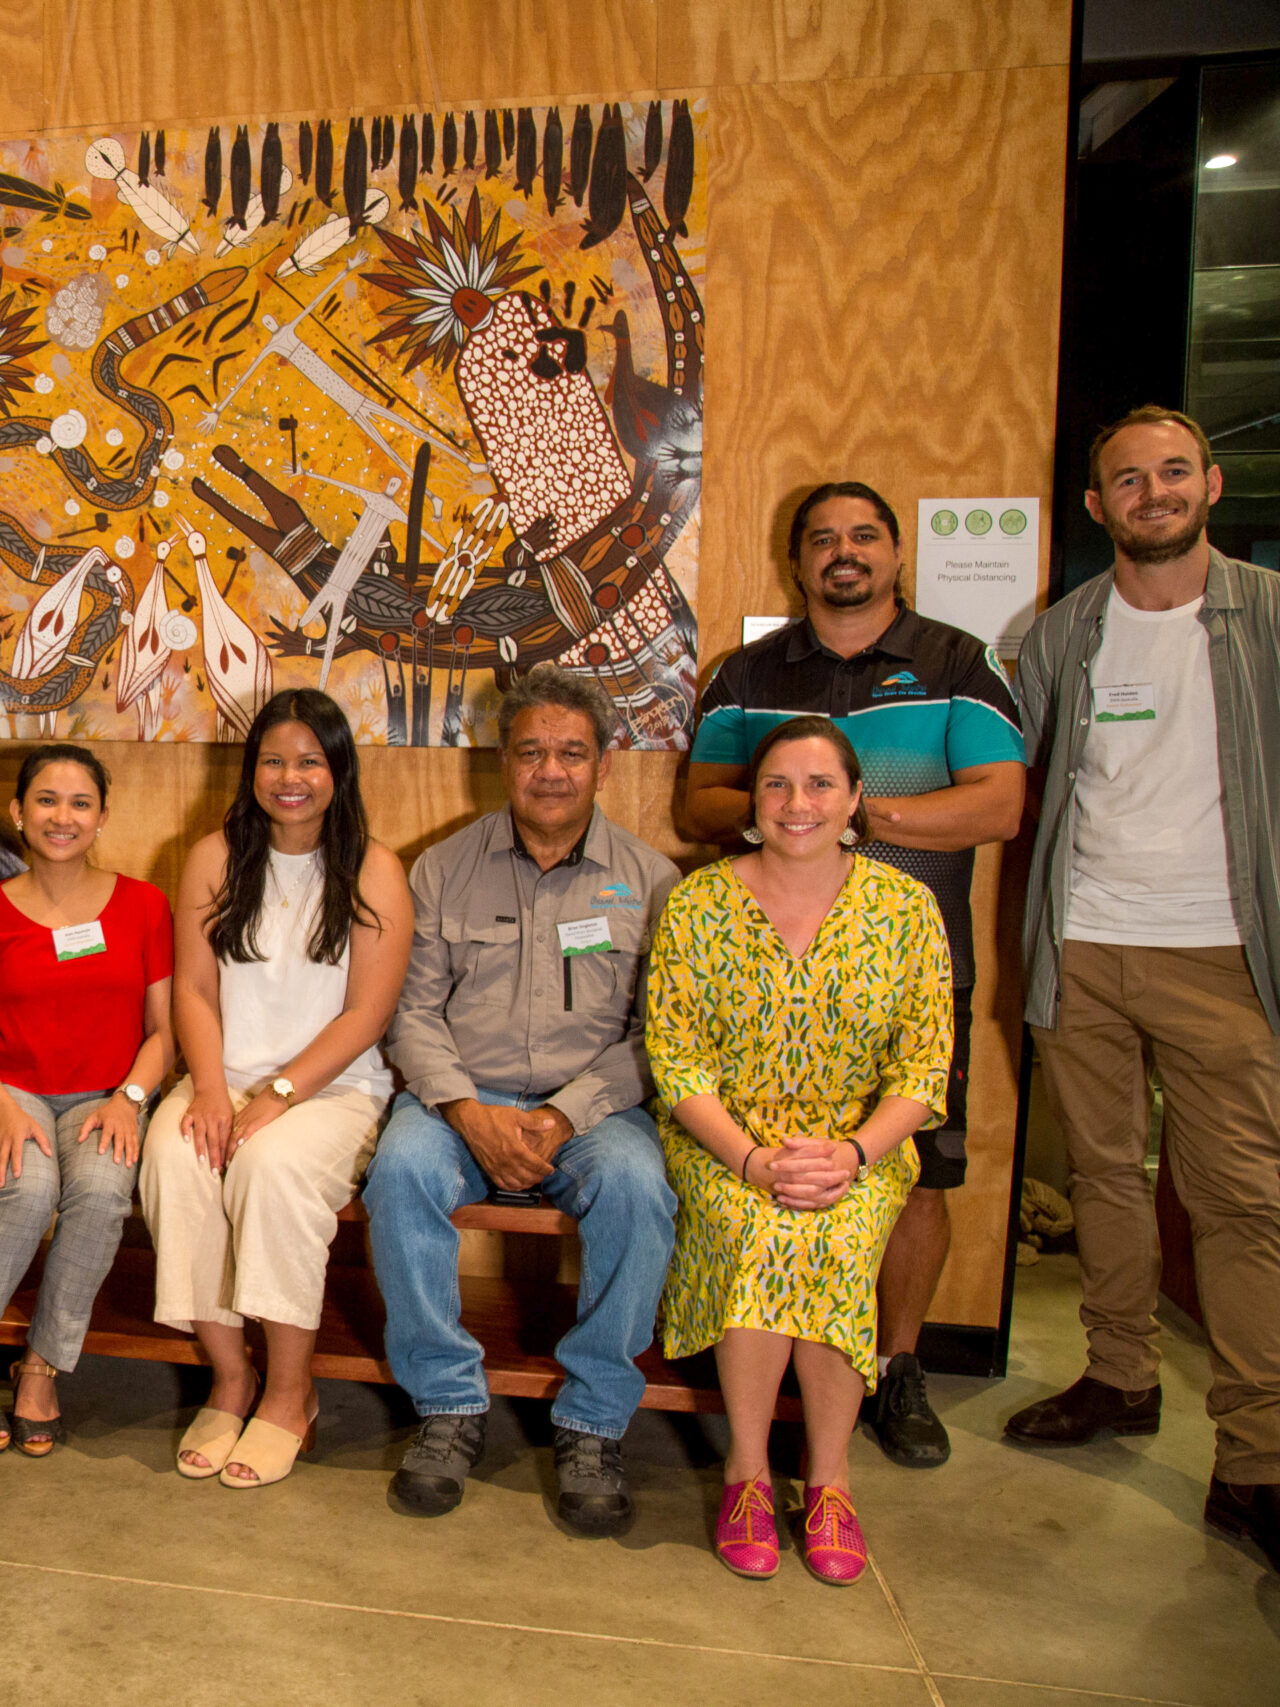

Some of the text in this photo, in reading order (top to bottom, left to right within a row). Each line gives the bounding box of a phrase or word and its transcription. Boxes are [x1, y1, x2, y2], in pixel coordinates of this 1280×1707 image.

[945, 560, 1010, 569] Please Maintain
[937, 573, 1017, 583] Physical Distancing
